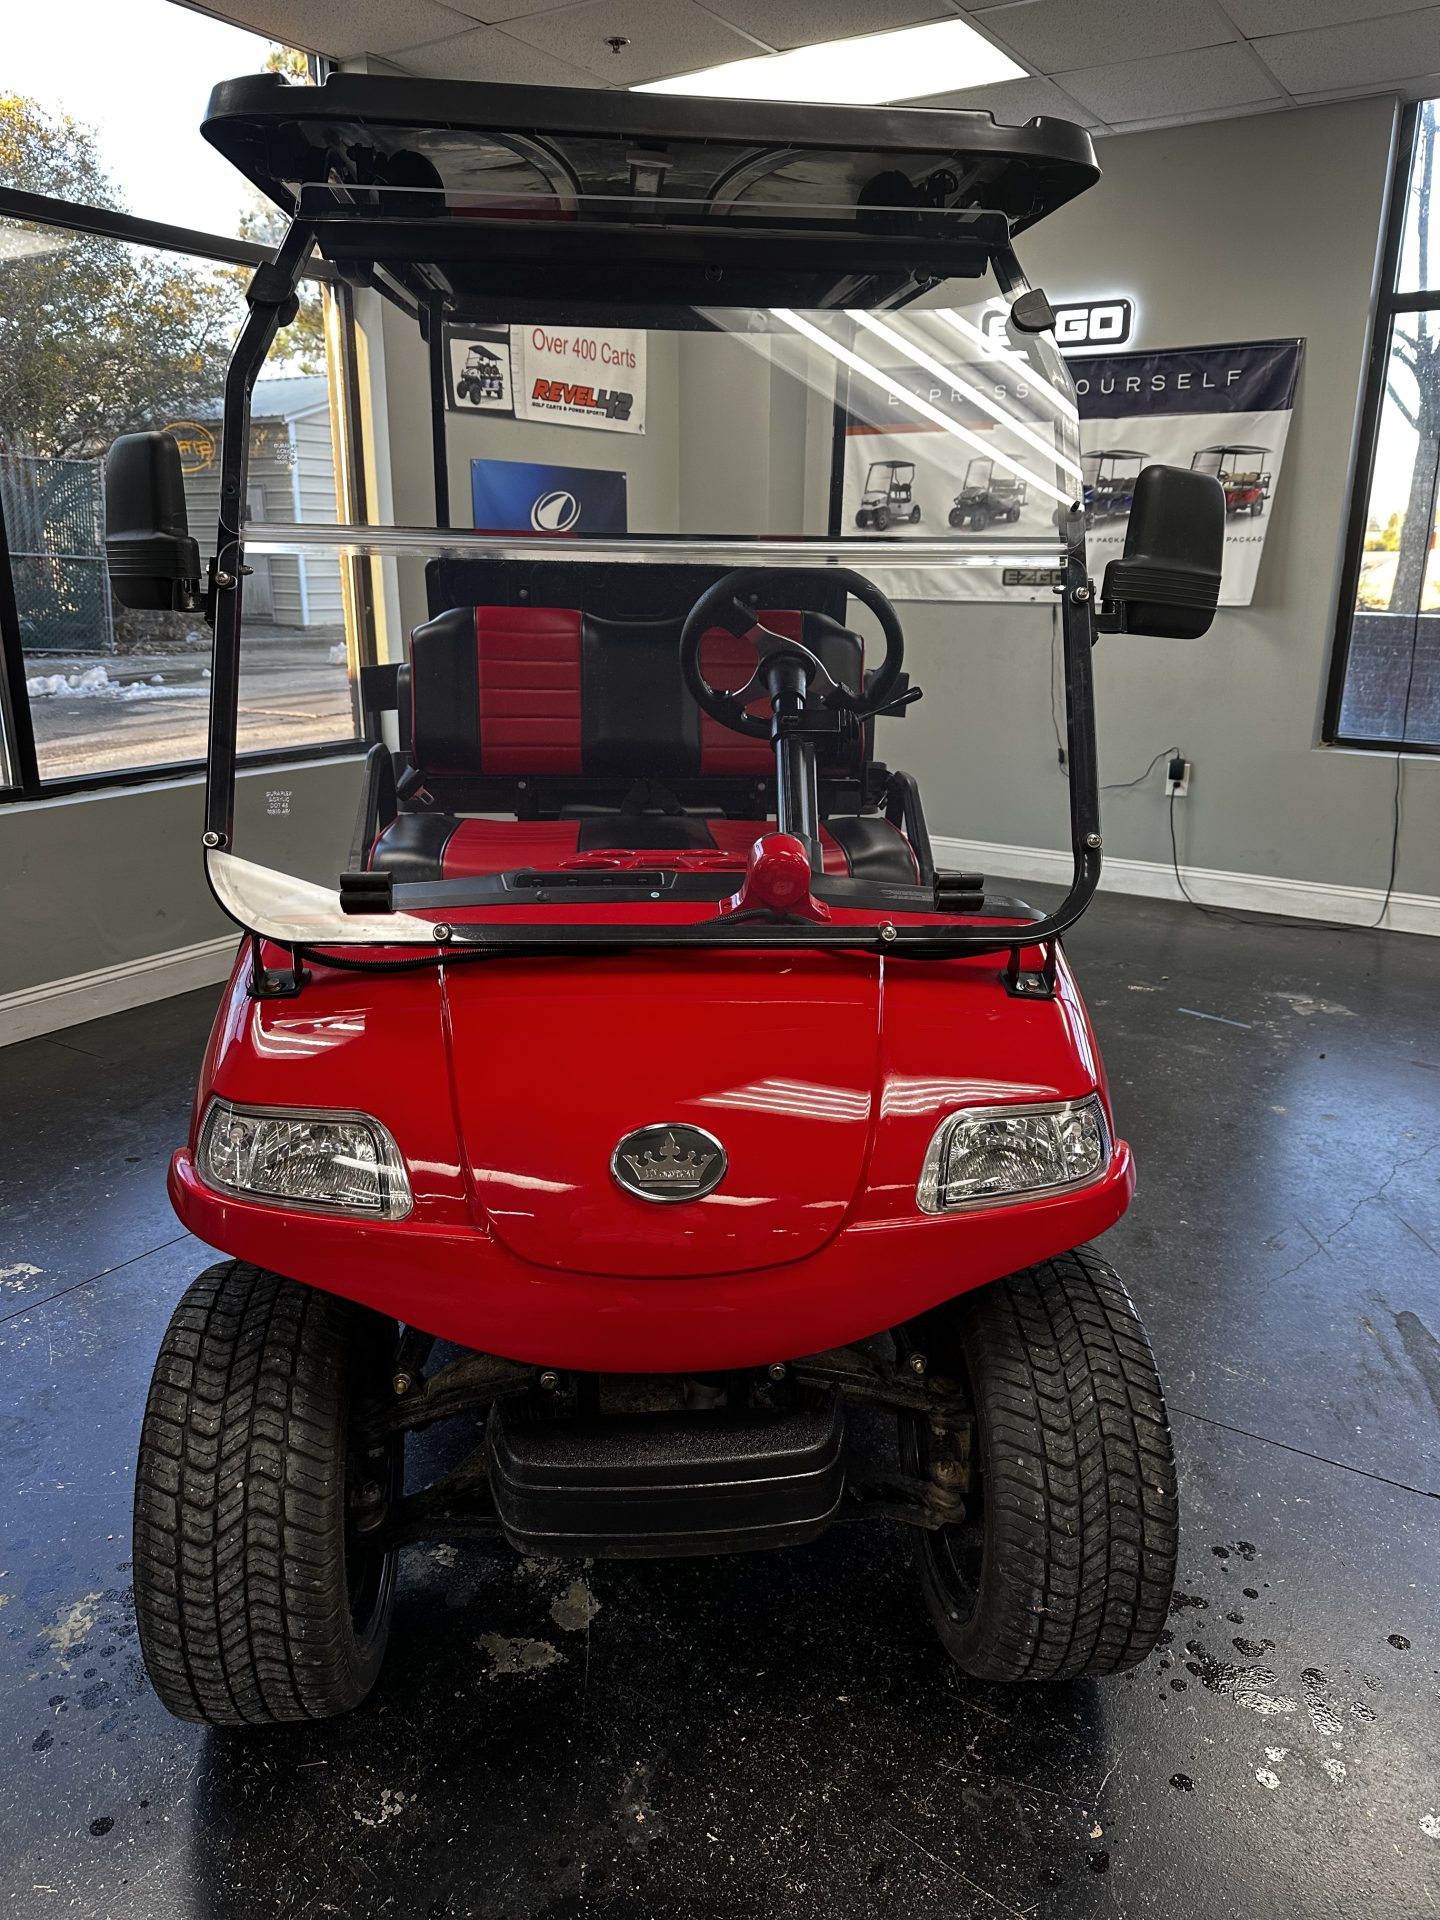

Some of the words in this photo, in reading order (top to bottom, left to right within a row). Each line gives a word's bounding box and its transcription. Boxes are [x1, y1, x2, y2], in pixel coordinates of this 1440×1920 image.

[988, 304, 1124, 347] EGO
[532, 328, 568, 355] Over
[572, 337, 597, 361] 400
[601, 342, 636, 369] Carts
[888, 383, 1029, 405] EPRSS
[1075, 370, 1242, 395] OURSELF
[546, 403, 562, 411] CARTS
